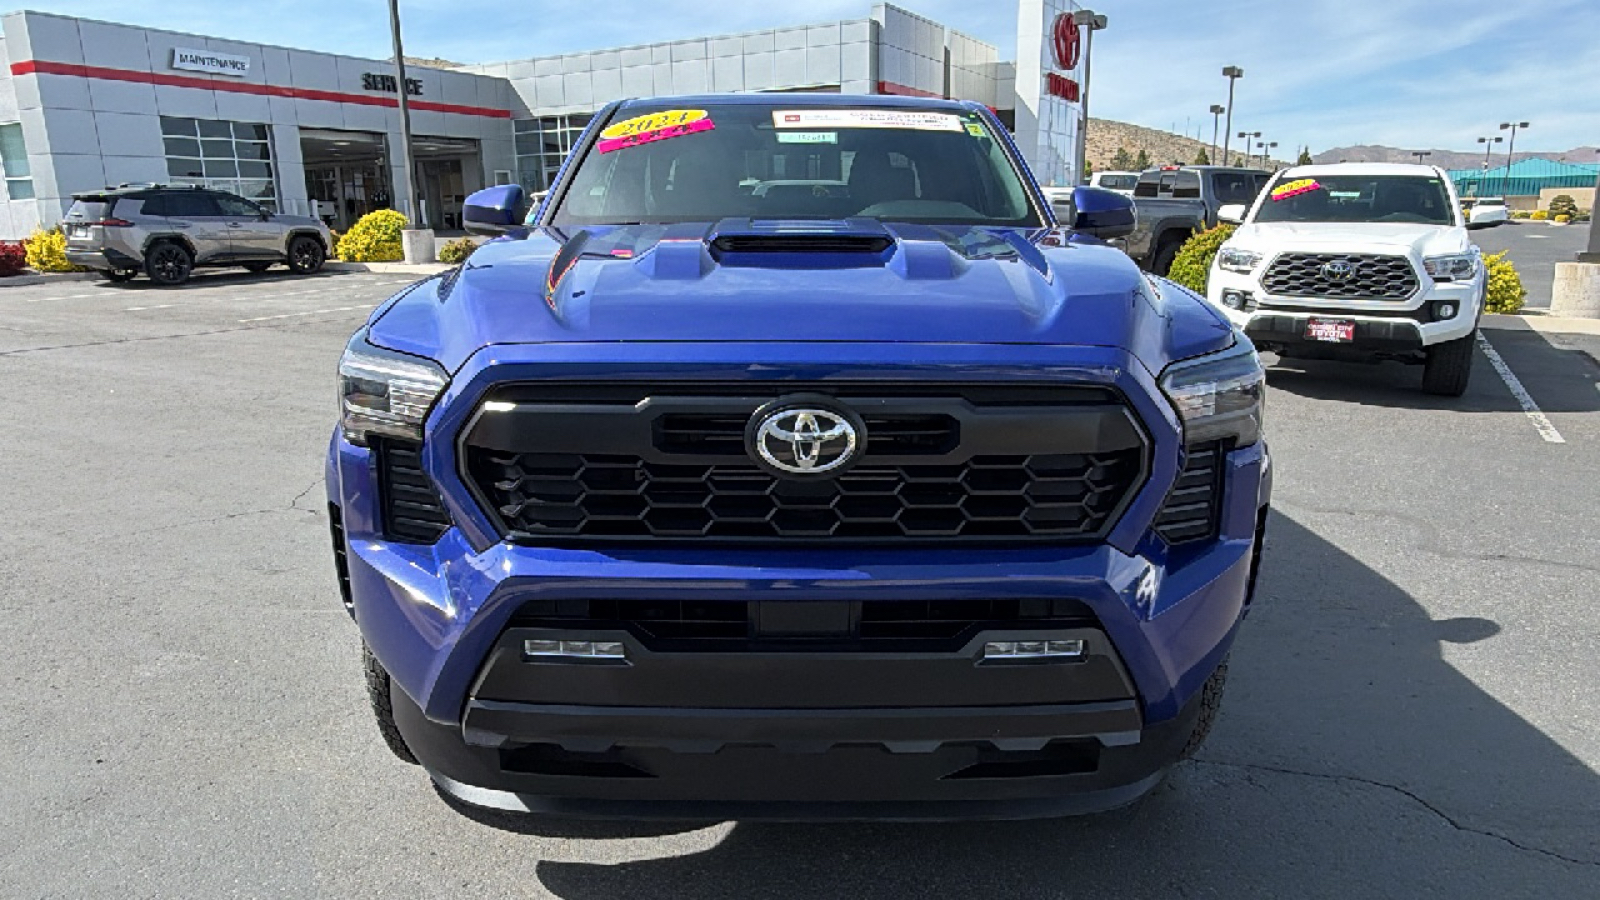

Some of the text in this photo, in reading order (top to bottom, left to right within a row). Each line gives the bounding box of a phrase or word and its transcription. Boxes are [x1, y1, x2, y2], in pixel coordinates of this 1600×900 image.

[179, 53, 246, 71] MAINTENANCE
[362, 72, 423, 95] SERVCE
[618, 111, 688, 136] 2024
[1311, 329, 1346, 338] TOYOTA
